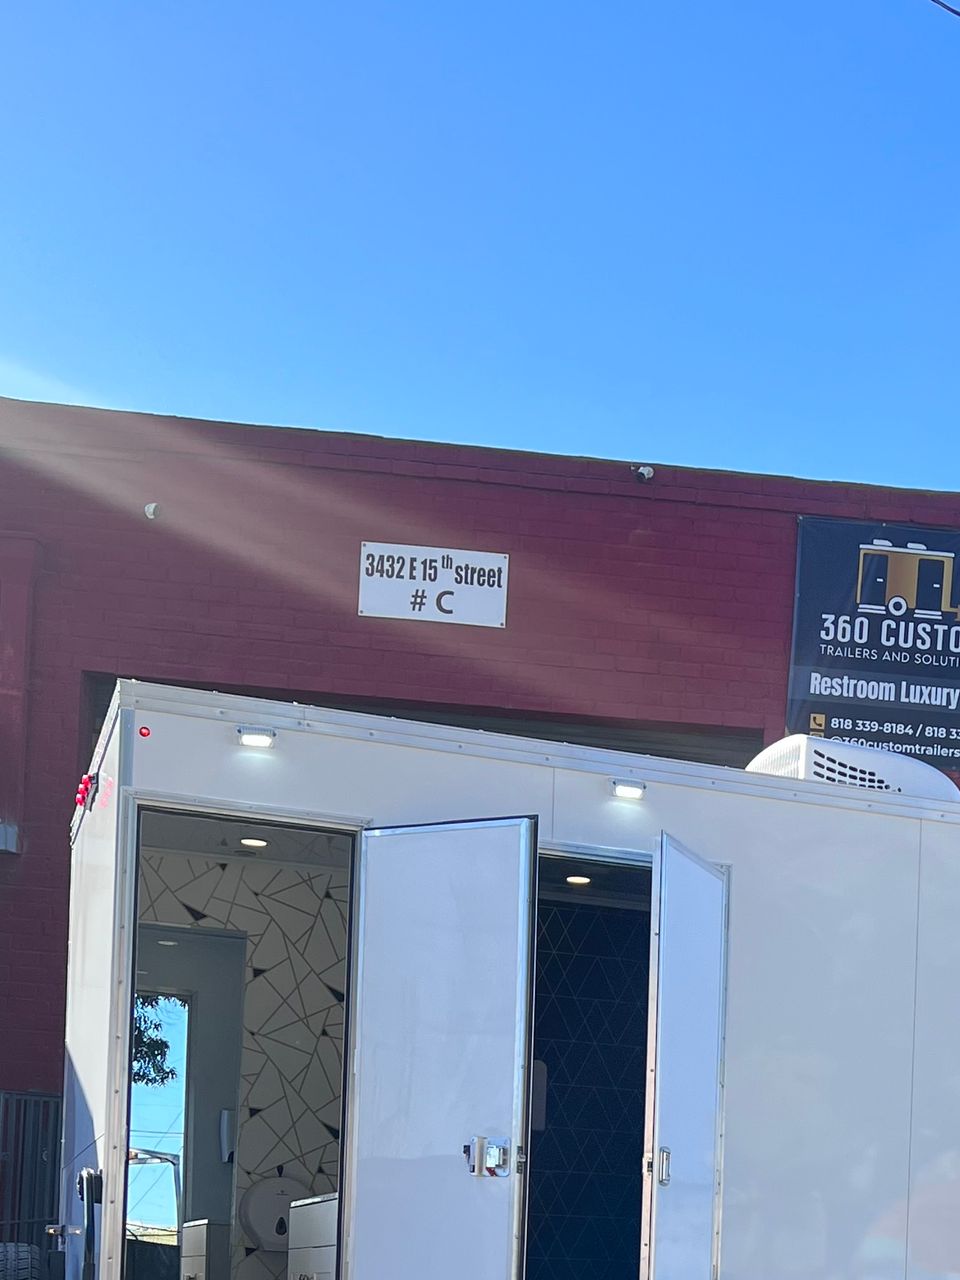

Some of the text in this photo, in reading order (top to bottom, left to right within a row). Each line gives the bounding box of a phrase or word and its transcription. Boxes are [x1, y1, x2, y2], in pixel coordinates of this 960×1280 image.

[365, 553, 405, 580] 3432
[409, 557, 417, 581] E
[454, 563, 503, 589] street
[410, 589, 455, 614] # C
[819, 613, 869, 644] 360
[819, 643, 878, 661] TRAILERS
[882, 651, 910, 663] AND
[809, 672, 896, 702] Restroom
[900, 681, 960, 710] Luxury
[830, 717, 852, 731] 818
[855, 719, 914, 737] 339-8184
[924, 725, 946, 739] 818
